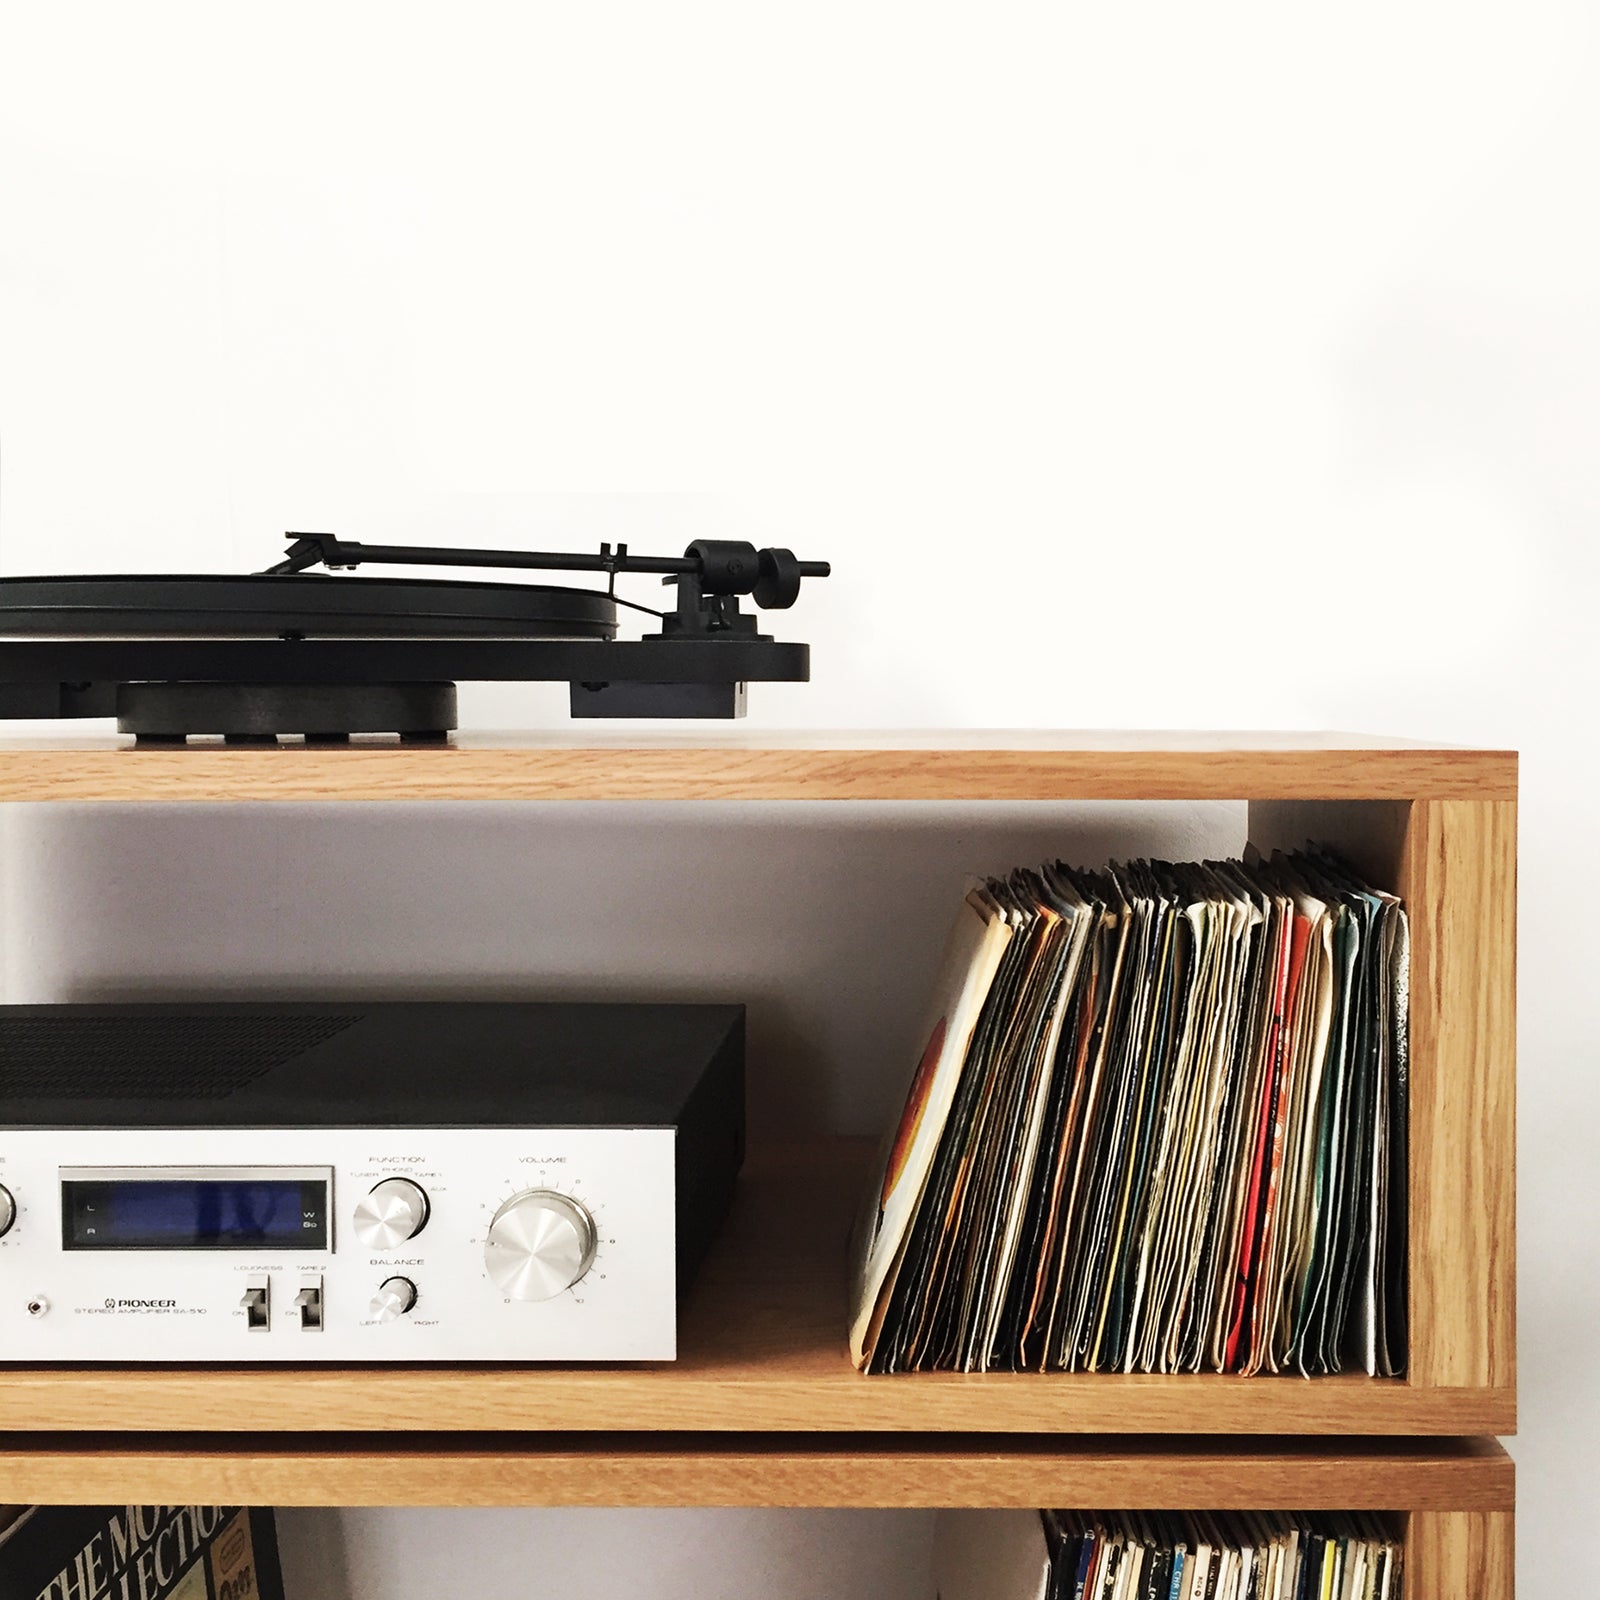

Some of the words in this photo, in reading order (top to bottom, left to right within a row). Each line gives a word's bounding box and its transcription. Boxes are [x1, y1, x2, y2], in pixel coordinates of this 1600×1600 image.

[369, 1258, 425, 1266] BALANCE
[118, 1299, 176, 1308] PIONEER
[35, 1531, 108, 1600] THE
[108, 1505, 177, 1577] MO
